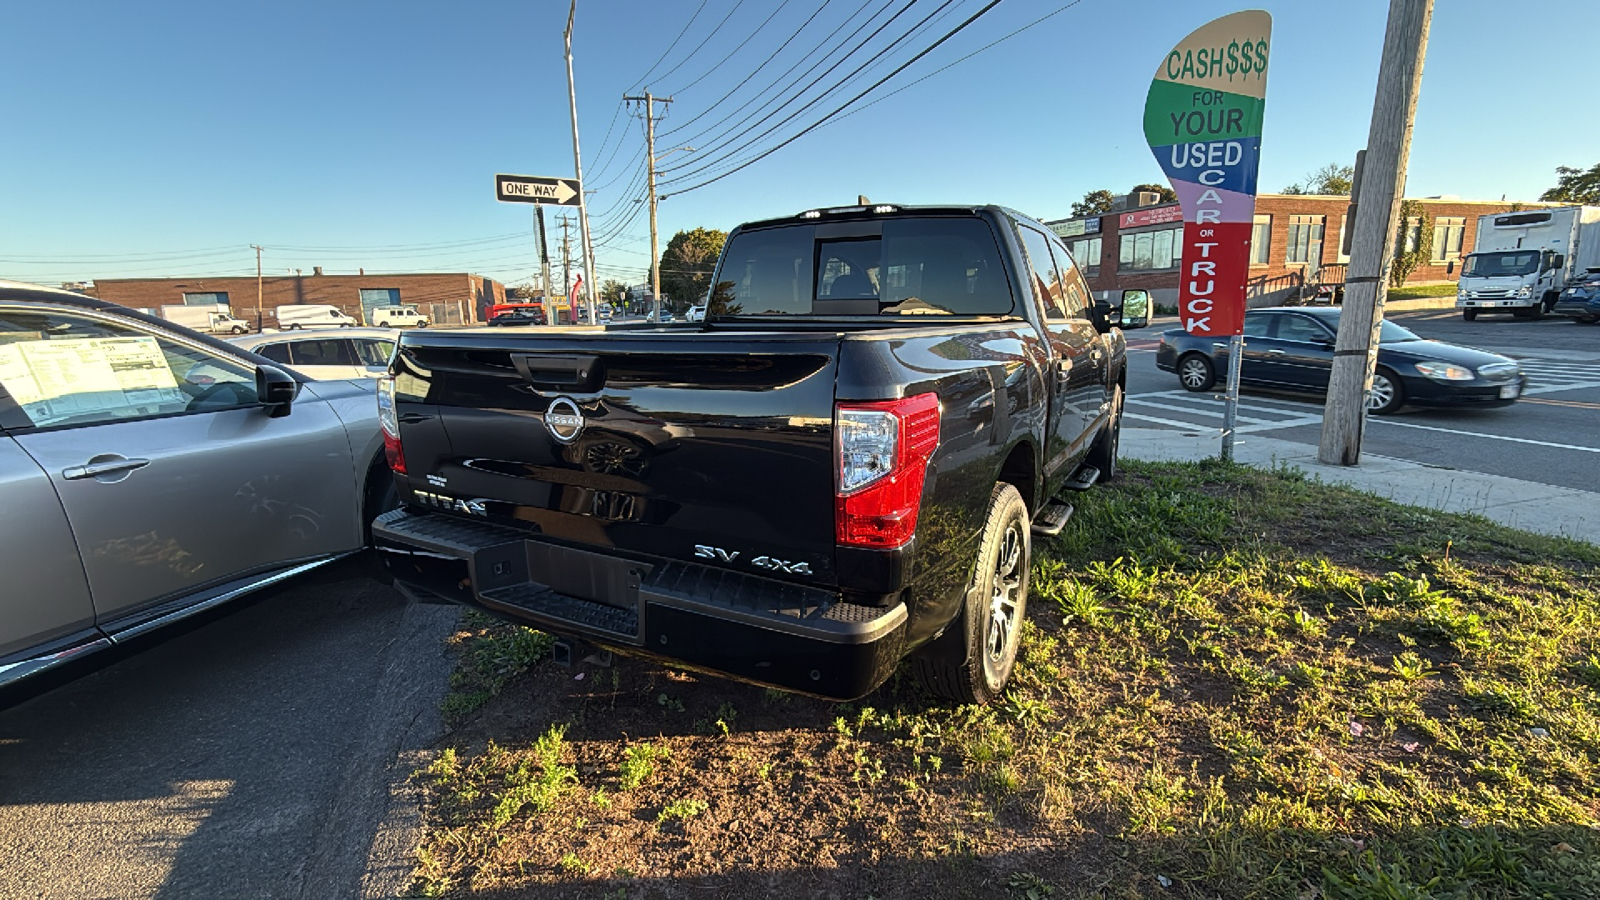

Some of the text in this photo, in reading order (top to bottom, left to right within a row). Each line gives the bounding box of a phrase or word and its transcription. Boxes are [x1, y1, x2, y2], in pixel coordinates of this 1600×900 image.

[1167, 37, 1267, 82] CASH$$$
[1193, 91, 1224, 107] FOR
[1170, 108, 1243, 136] YOUR
[1171, 142, 1242, 168] USED
[506, 183, 557, 197] ONE WAY
[1196, 169, 1225, 225] CAR
[1200, 229, 1214, 238] OR
[1186, 242, 1219, 333] TRUCK
[545, 415, 583, 426] NISSAN
[414, 489, 488, 517] TITAN
[694, 544, 740, 562] SV
